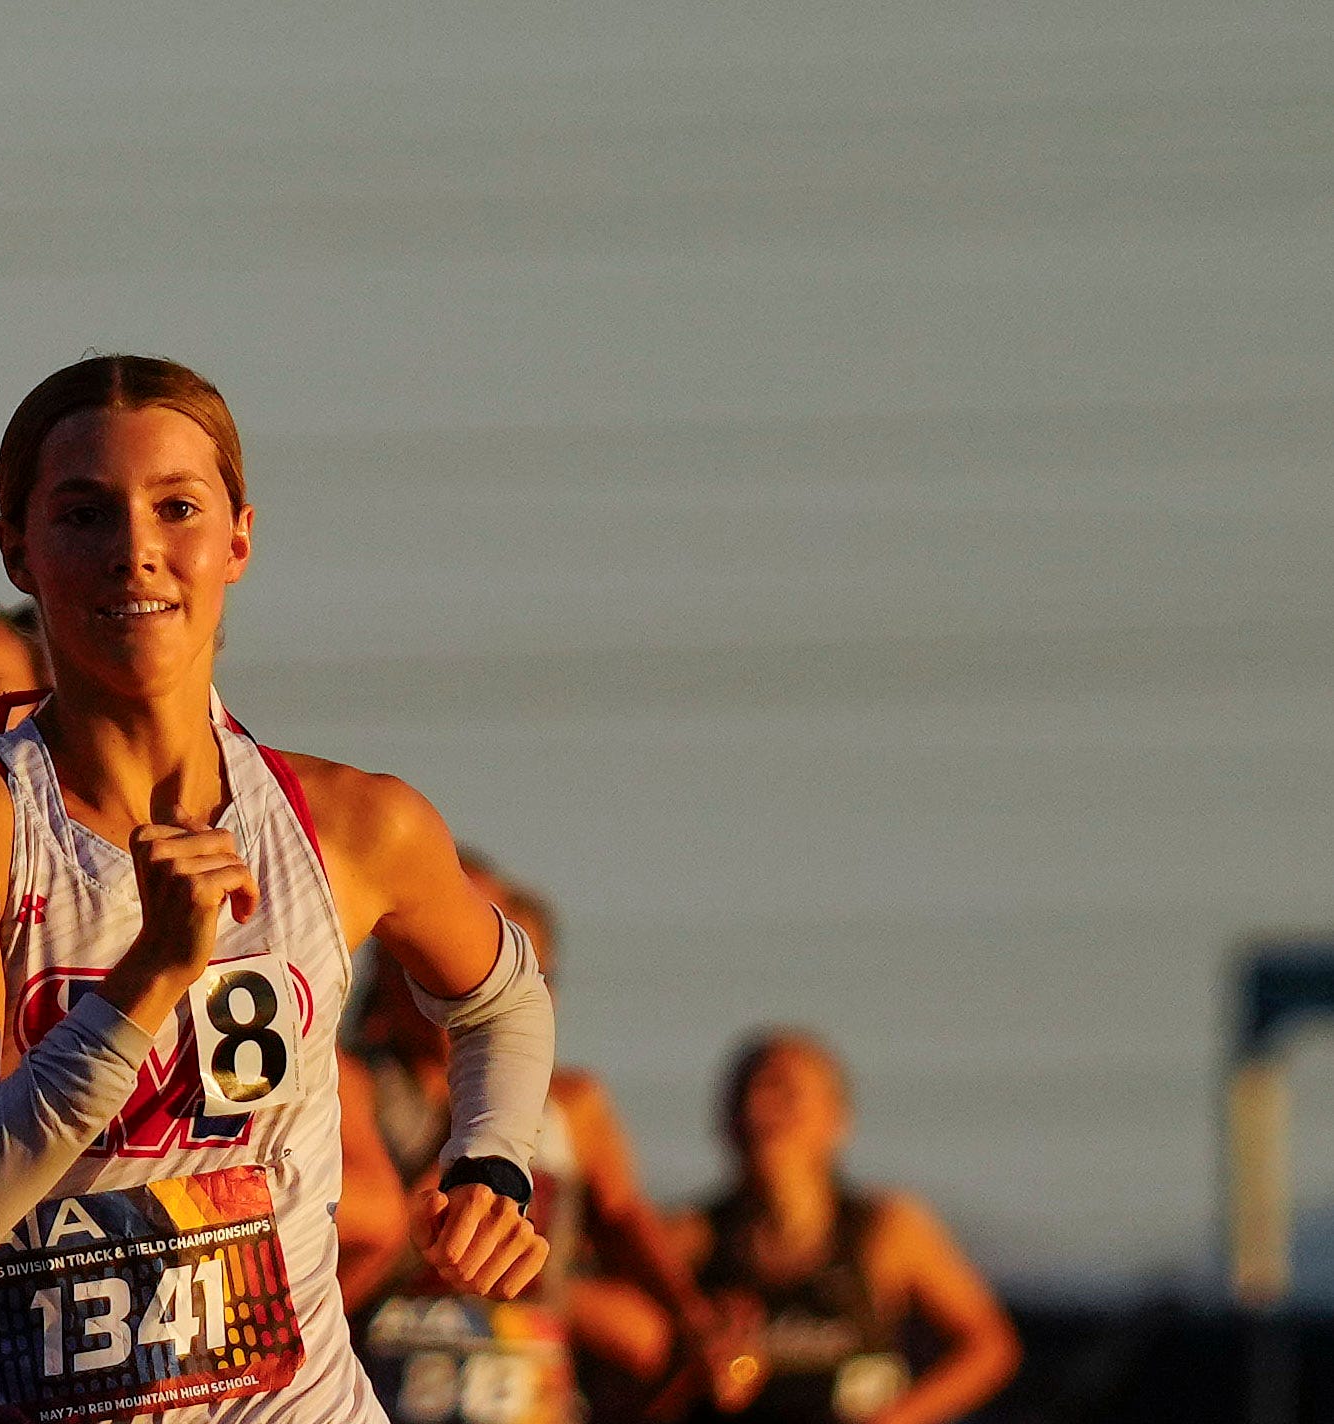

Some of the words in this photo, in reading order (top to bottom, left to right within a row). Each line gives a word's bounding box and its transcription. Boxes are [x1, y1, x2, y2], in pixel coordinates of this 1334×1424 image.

[206, 970, 287, 1102] 8
[7, 1256, 65, 1277] DIVISION
[65, 1248, 114, 1269] TRACK
[114, 1247, 126, 1259] &
[127, 1240, 167, 1261] FIELD
[168, 1220, 271, 1250] CHAMPIONSHIPS
[30, 1258, 226, 1377] 1341
[39, 1407, 66, 1422] MAY
[66, 1404, 86, 1418] 7-9
[88, 1400, 113, 1415] RED
[115, 1389, 179, 1411] MOUNTAIN
[180, 1382, 210, 1399] HIGH
[211, 1374, 260, 1394] SCHOOL
